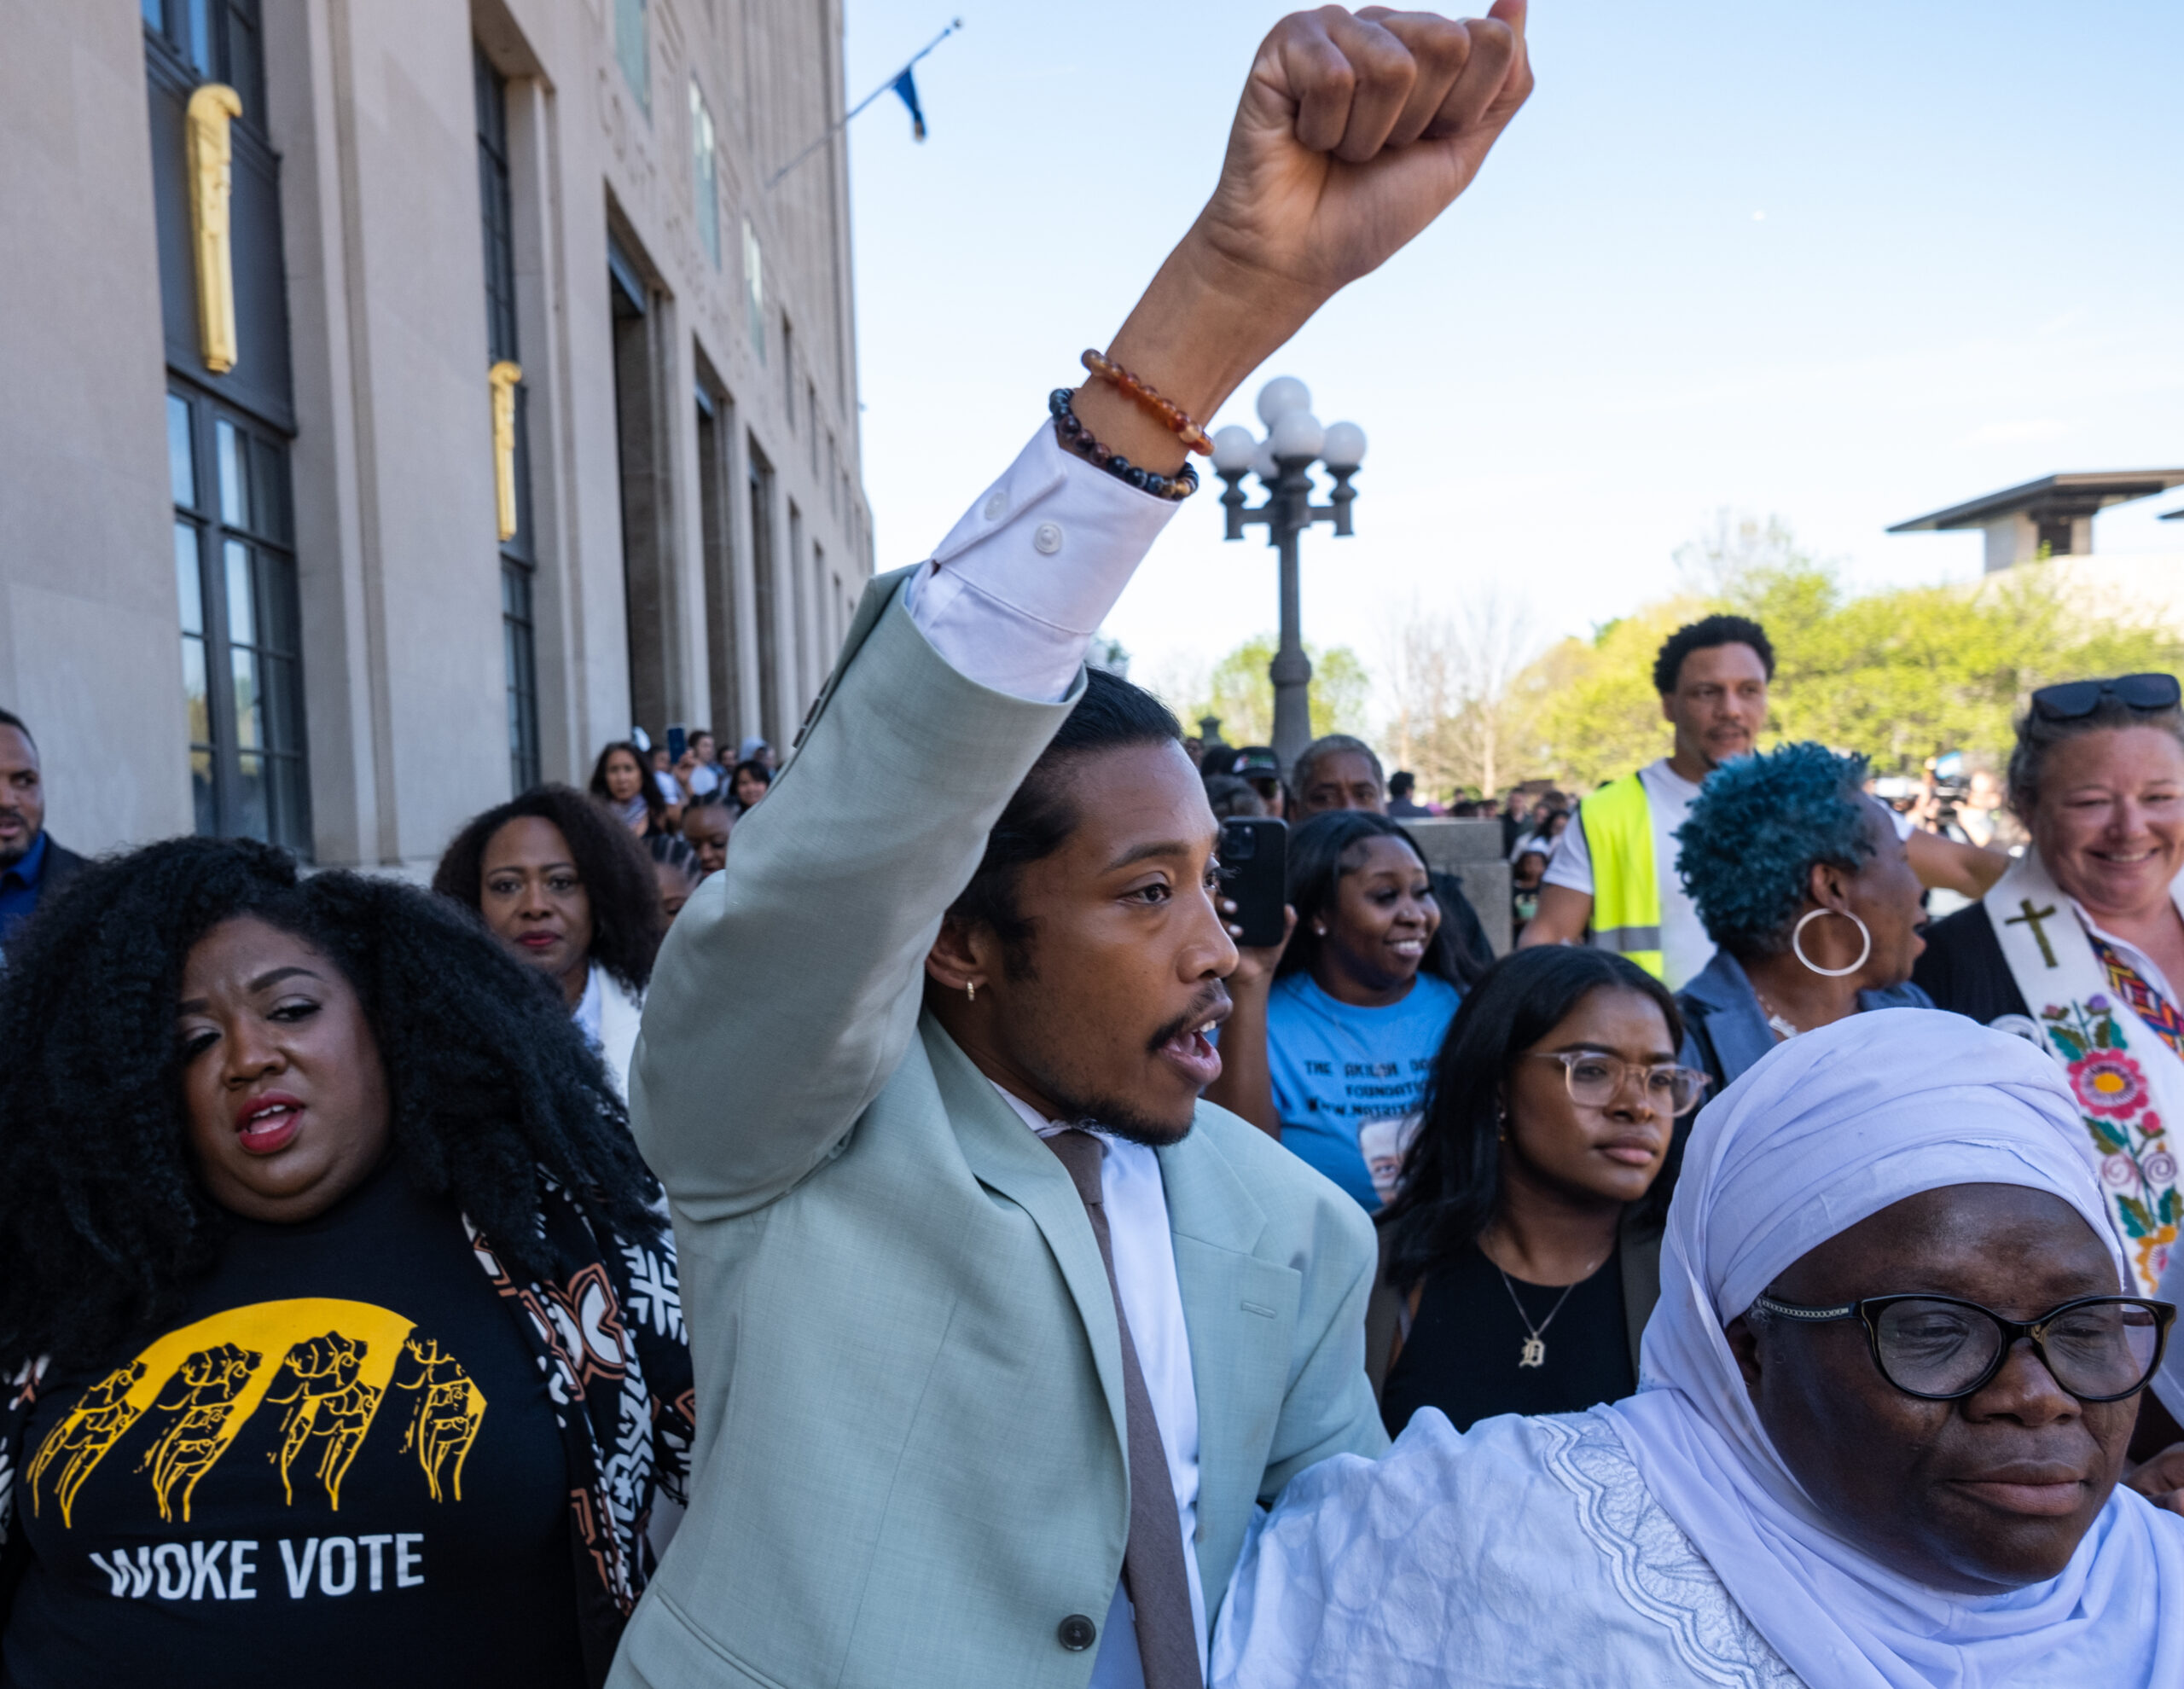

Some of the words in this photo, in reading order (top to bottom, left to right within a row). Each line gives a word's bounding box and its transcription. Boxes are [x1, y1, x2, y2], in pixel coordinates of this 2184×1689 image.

[1304, 1059, 1332, 1075] THE
[88, 1540, 258, 1600] WOKE
[278, 1533, 425, 1599] VOTE
